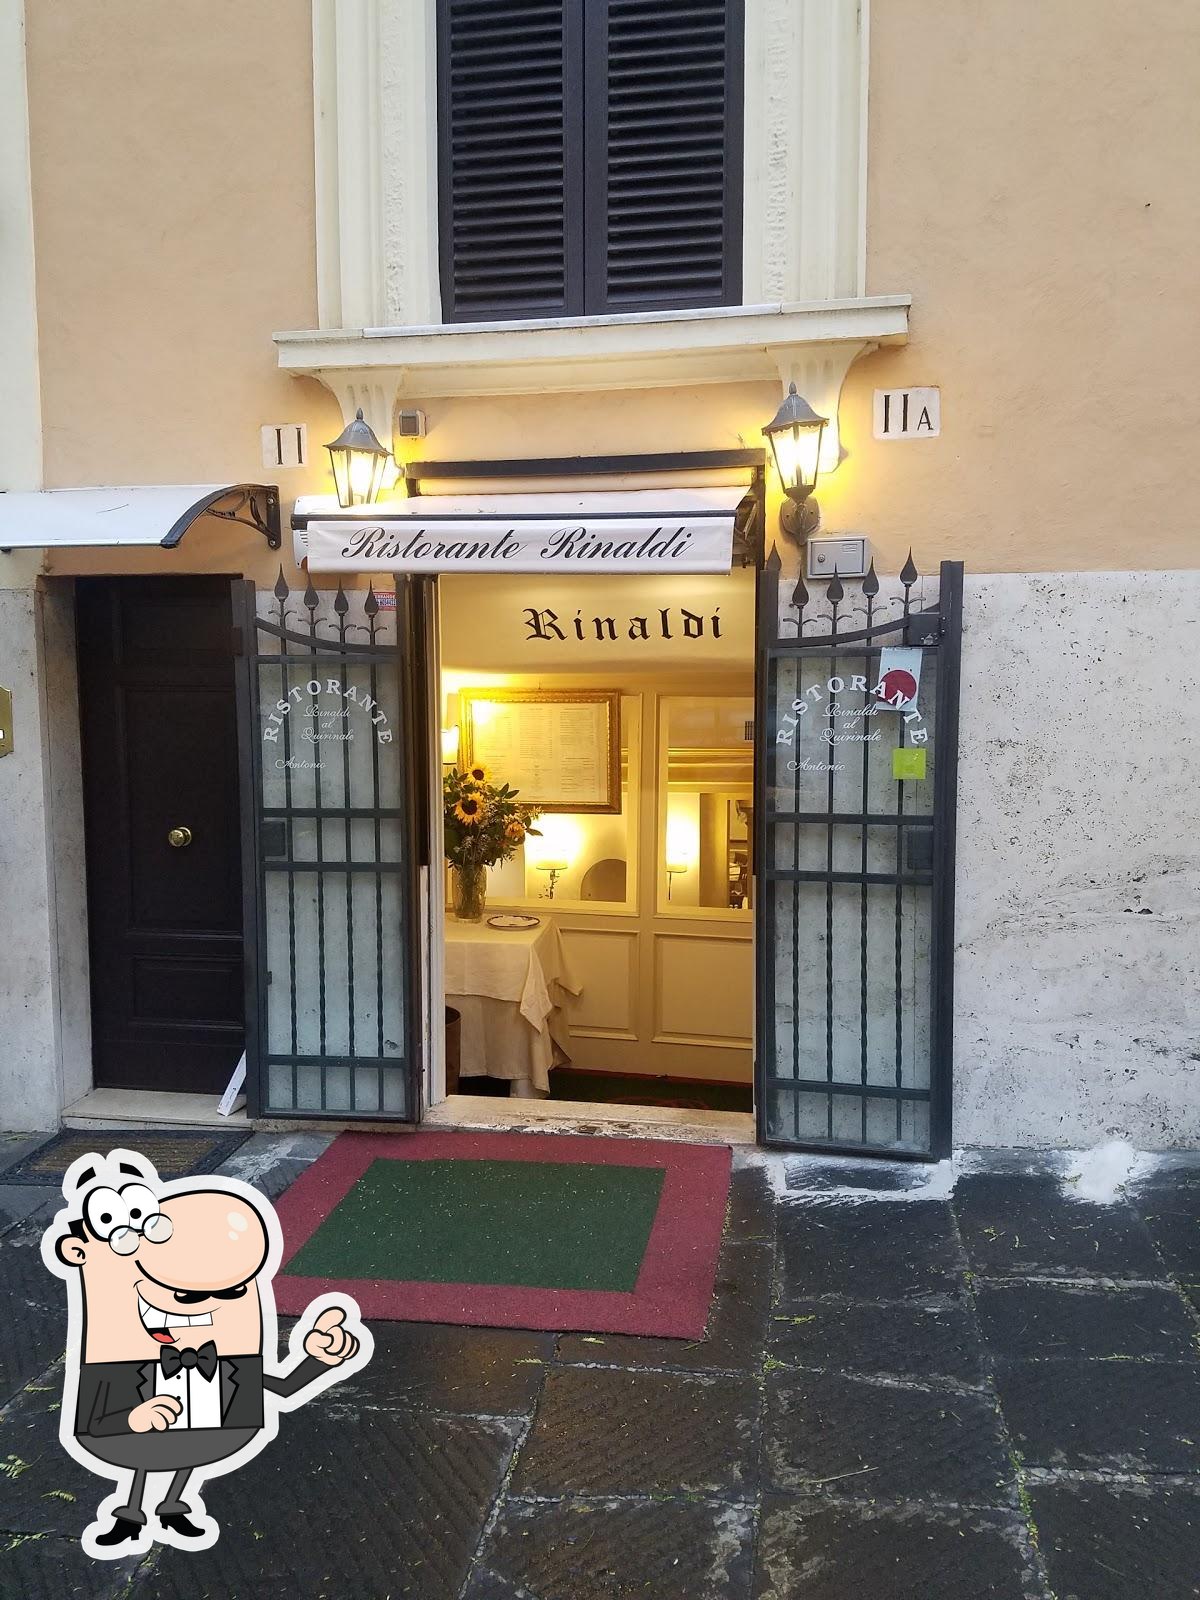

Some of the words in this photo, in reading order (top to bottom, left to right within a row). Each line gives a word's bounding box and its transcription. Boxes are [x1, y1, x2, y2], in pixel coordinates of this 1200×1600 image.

[342, 527, 527, 559] Ristorante
[540, 526, 695, 559] Rinaldi
[522, 607, 724, 641] Rinaldi
[263, 679, 393, 744] RISTORANTE
[303, 704, 351, 717] Rinaldi
[776, 675, 928, 746] RISTORANTE
[822, 703, 878, 717] Rinaldi
[321, 719, 334, 729] al
[843, 717, 859, 729] al
[301, 727, 354, 744] Quirinale
[819, 728, 882, 746] Quirinale
[275, 756, 326, 769] Antonio
[787, 757, 845, 771] Antonio
